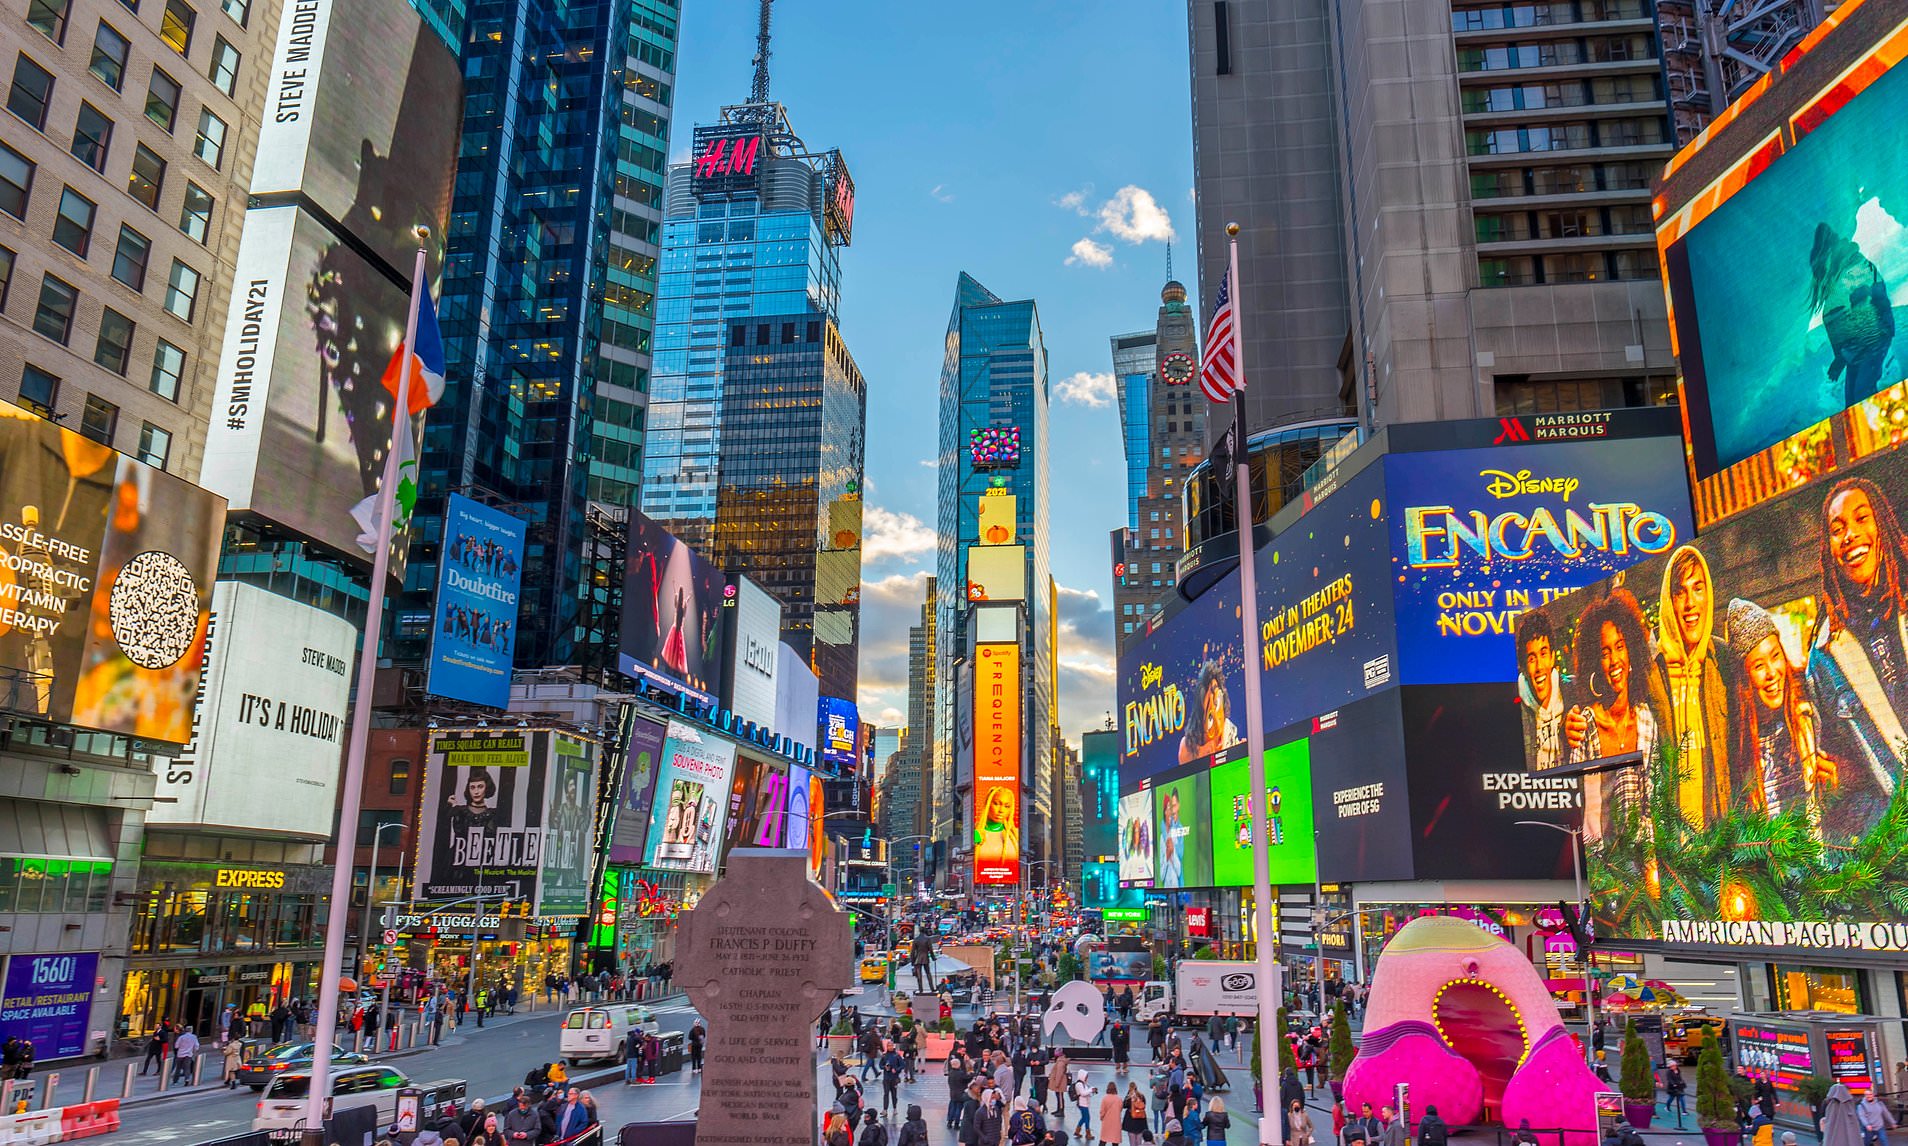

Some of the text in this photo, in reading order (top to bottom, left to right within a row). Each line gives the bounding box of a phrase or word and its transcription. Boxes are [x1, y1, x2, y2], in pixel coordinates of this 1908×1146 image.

[276, 0, 319, 123] STEVE MADDE
[696, 136, 760, 178] H&M
[227, 279, 268, 430] #SMHOLIDAY21
[1535, 412, 1612, 426] MARRIOTT
[1536, 423, 1606, 438] MARQUIS
[985, 487, 1007, 497] 2021
[1405, 502, 1676, 568] ENCANTO
[447, 568, 516, 604] Doubtfire
[723, 599, 735, 607] LG
[1263, 573, 1353, 641] ONLY IN THEATERS
[1437, 590, 1496, 609] ONLY
[1505, 588, 1530, 606] IN
[1336, 598, 1354, 635] 24
[302, 647, 346, 678] STEVE MADDEN
[239, 693, 340, 743] IT'S A HOLIDAY
[992, 661, 1003, 767] FREQUENCY
[1126, 683, 1186, 757] ENCANTO
[457, 740, 482, 752] SQUARE
[483, 739, 496, 749] CAN
[497, 738, 523, 749] REALLY
[672, 753, 704, 773] SOUVENIR
[704, 764, 724, 780] PHOTO
[1333, 782, 1384, 805] EXPERIENCE THE
[1499, 792, 1572, 809] POWER
[1338, 802, 1361, 818] POWER
[1361, 800, 1370, 814] OF
[453, 831, 540, 867] BEETLE
[216, 869, 285, 888] EXPRESS
[432, 916, 500, 928] LUGGAGE
[710, 938, 759, 950] FRANCIS
[775, 939, 817, 951] DUFFY
[1314, 932, 1346, 947] SPHORA
[1666, 921, 1774, 945] AMERICAN
[1784, 922, 1863, 948] EAGLE
[1549, 942, 1575, 971] T
[31, 956, 71, 984] 1560
[721, 967, 801, 977] CATHOLIC PRIEST
[3, 991, 90, 1009] RETAIL/RESTAURANT
[740, 989, 782, 999] CHAPLAIN
[1, 1004, 77, 1021] SPACE AVAILABLE
[728, 1038, 747, 1046] LIFE
[748, 1038, 760, 1046] OF
[763, 1038, 799, 1047] SERVICE
[1760, 1030, 1777, 1040] too
[1776, 1032, 1809, 1045] proud
[714, 1055, 801, 1065] GOD AND COUNTRY
